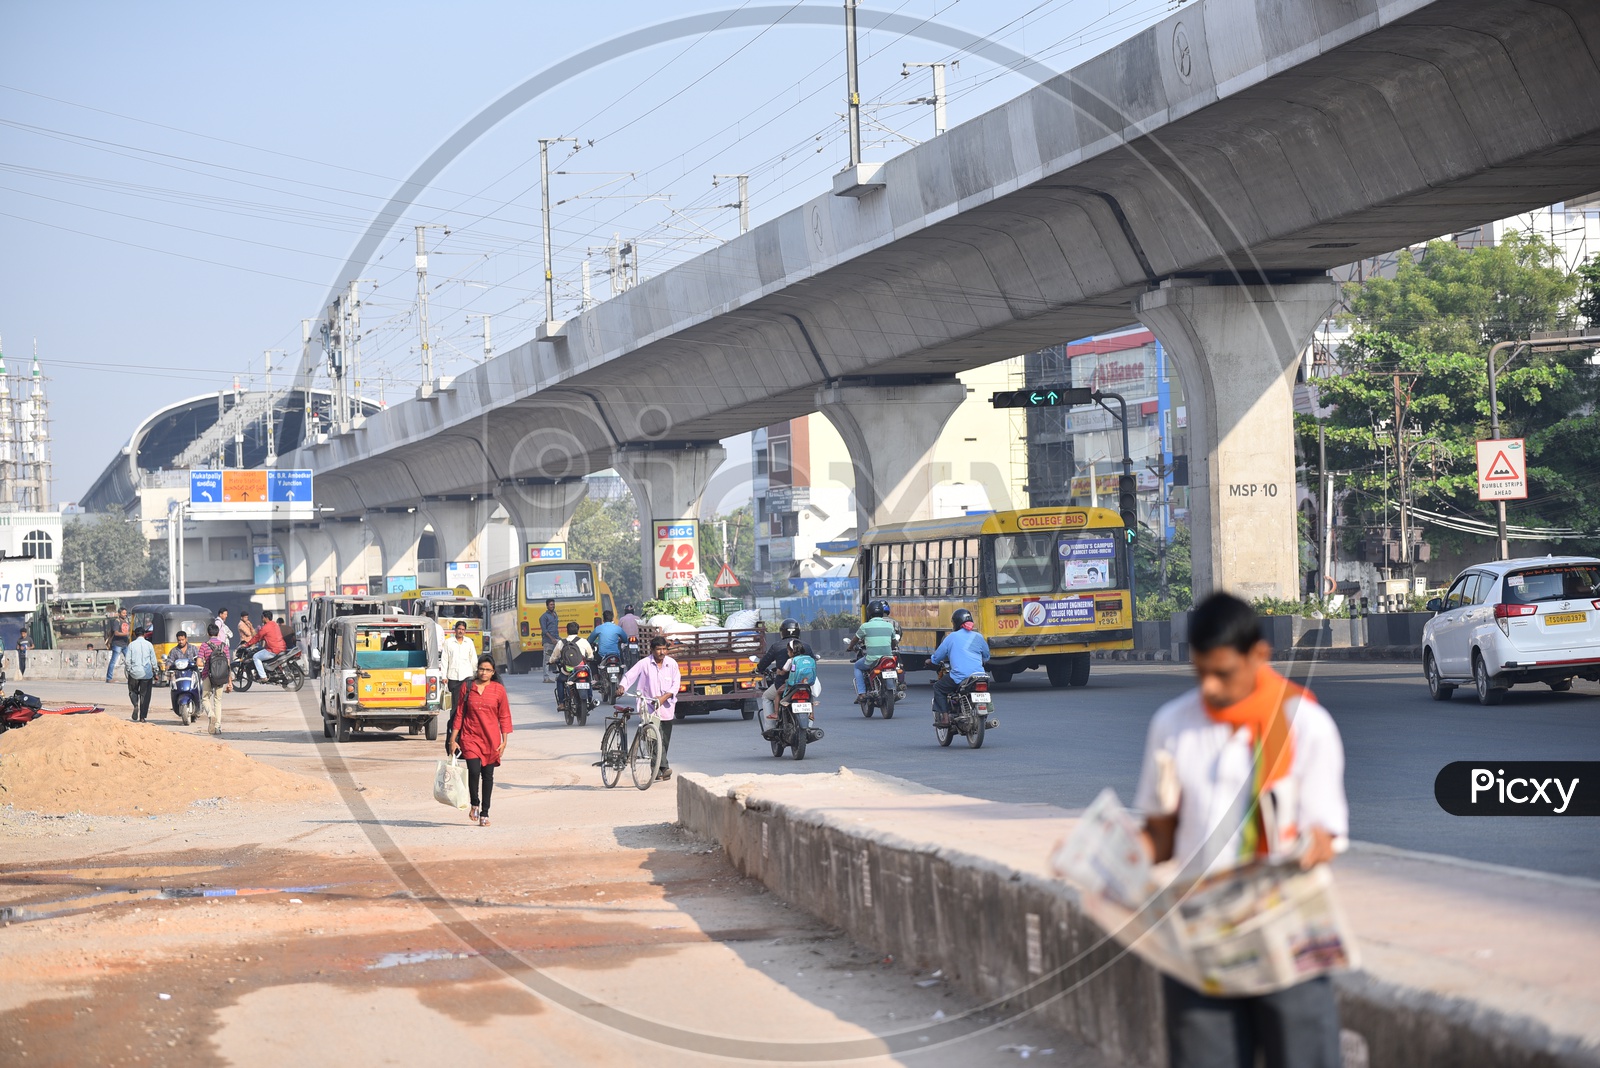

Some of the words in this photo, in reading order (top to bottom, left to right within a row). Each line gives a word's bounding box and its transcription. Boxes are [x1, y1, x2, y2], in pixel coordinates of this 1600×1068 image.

[192, 472, 221, 480] Kukatpally
[1230, 484, 1257, 497] MSP
[1021, 516, 1062, 527] COLLEGE
[1065, 515, 1084, 525] BUS
[669, 528, 685, 536] BIG
[686, 528, 693, 536] C
[541, 549, 554, 557] BIG
[555, 549, 561, 557] C
[659, 543, 695, 571] 42
[665, 571, 693, 579] CARS
[829, 580, 849, 588] RIGHT
[0, 584, 10, 602] 7
[15, 583, 33, 602] 87
[1069, 600, 1094, 608] ENGINEERING
[1074, 608, 1088, 616] WOMEN
[998, 619, 1019, 630] STOP
